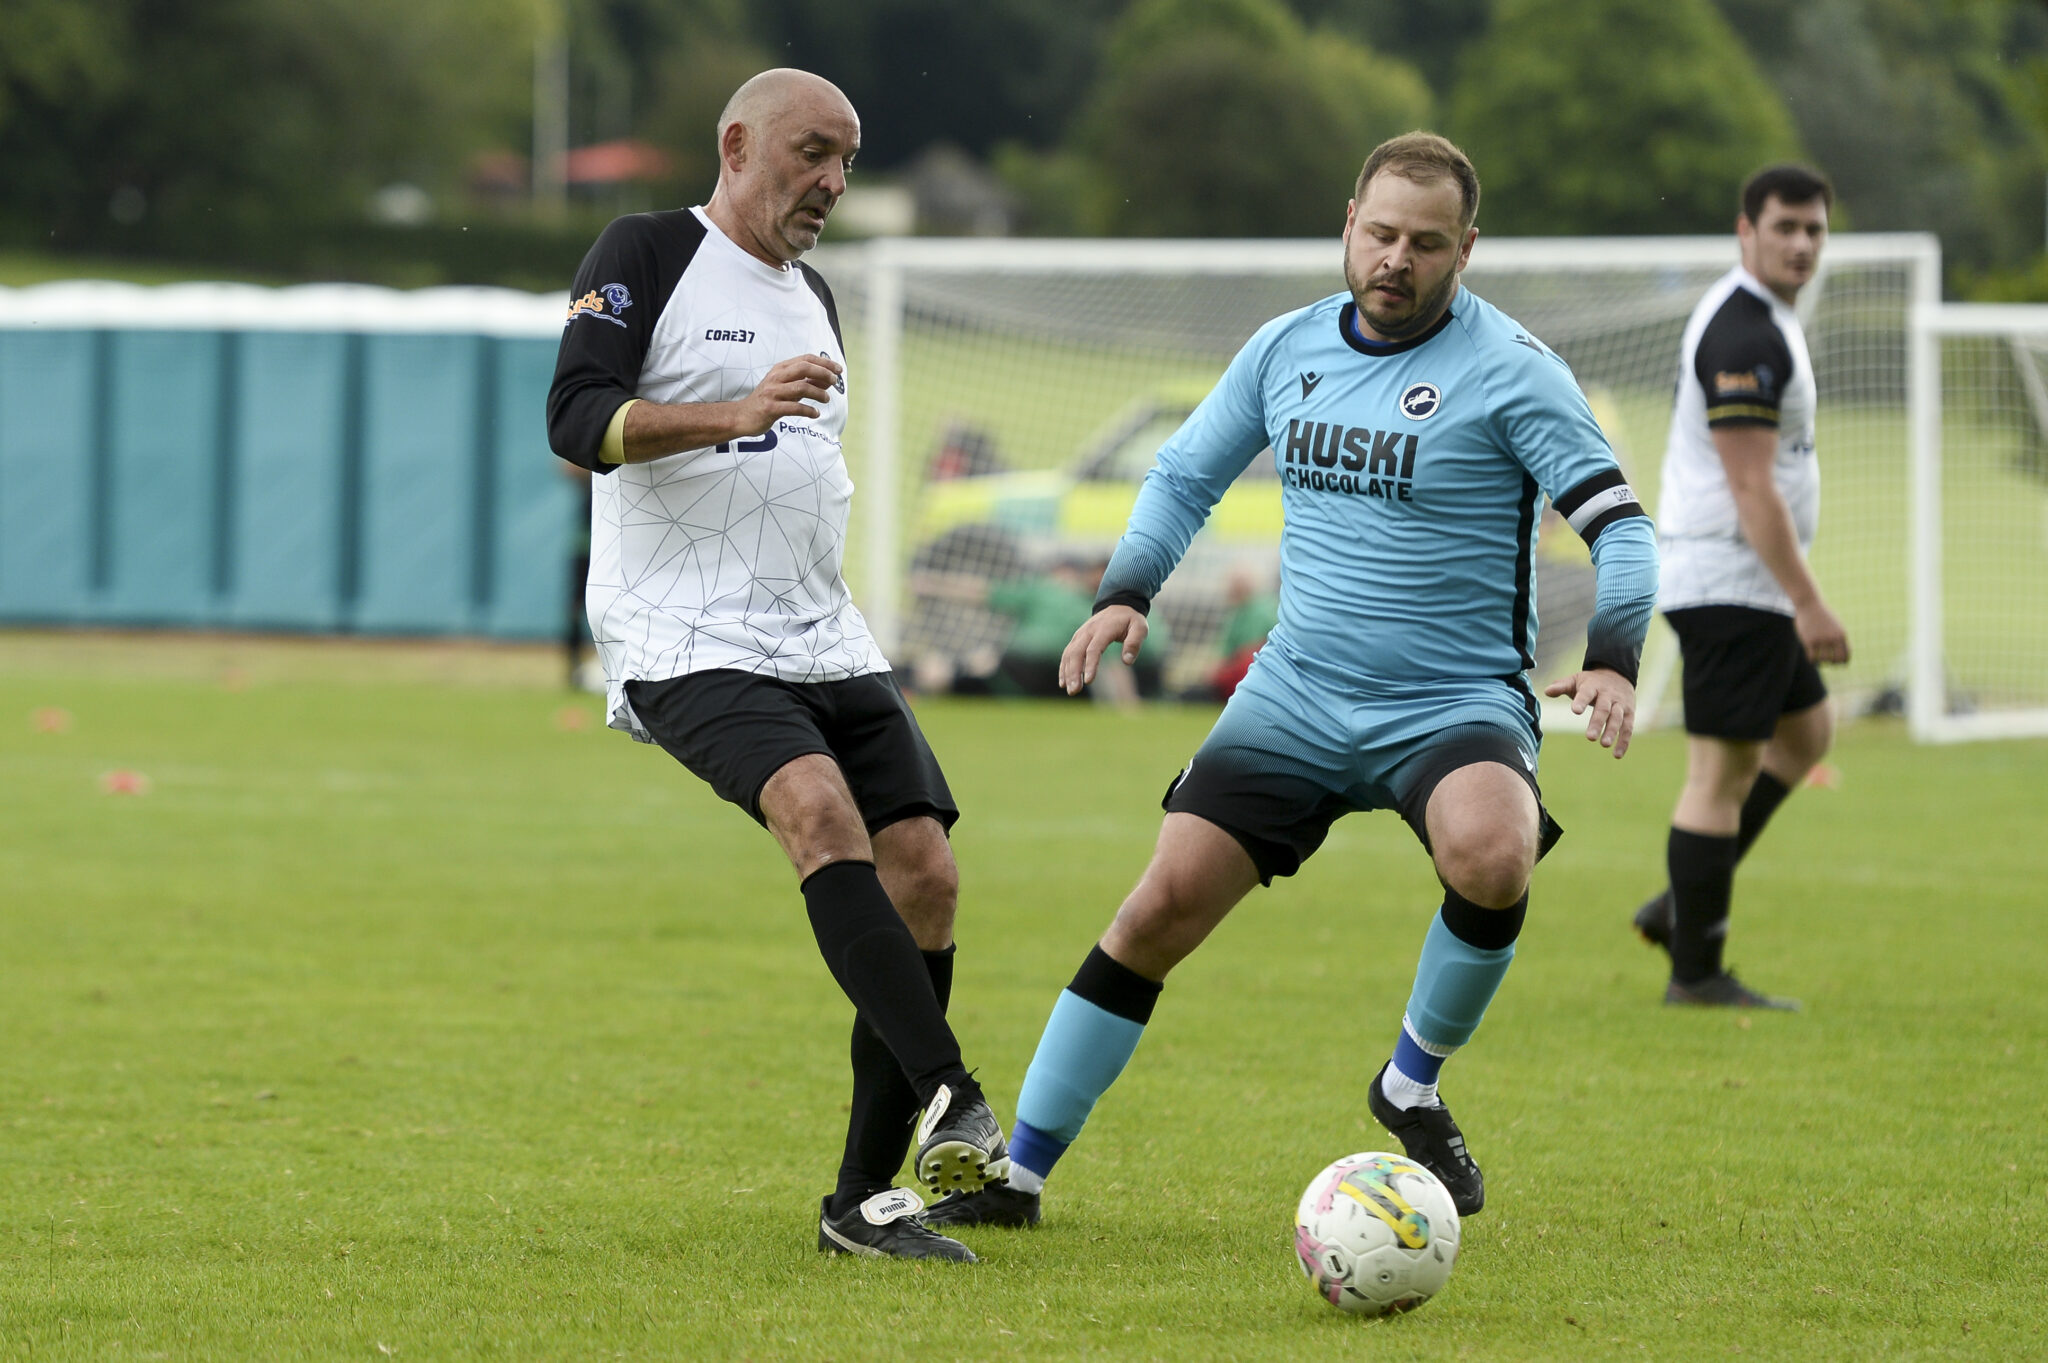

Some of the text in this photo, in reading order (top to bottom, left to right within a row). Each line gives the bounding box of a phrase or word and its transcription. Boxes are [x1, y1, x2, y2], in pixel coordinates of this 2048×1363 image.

[705, 329, 756, 344] CORE37
[1285, 418, 1419, 480] HUSKI
[1285, 467, 1414, 502] CHOCOLATE
[879, 1201, 907, 1215] PUMA
